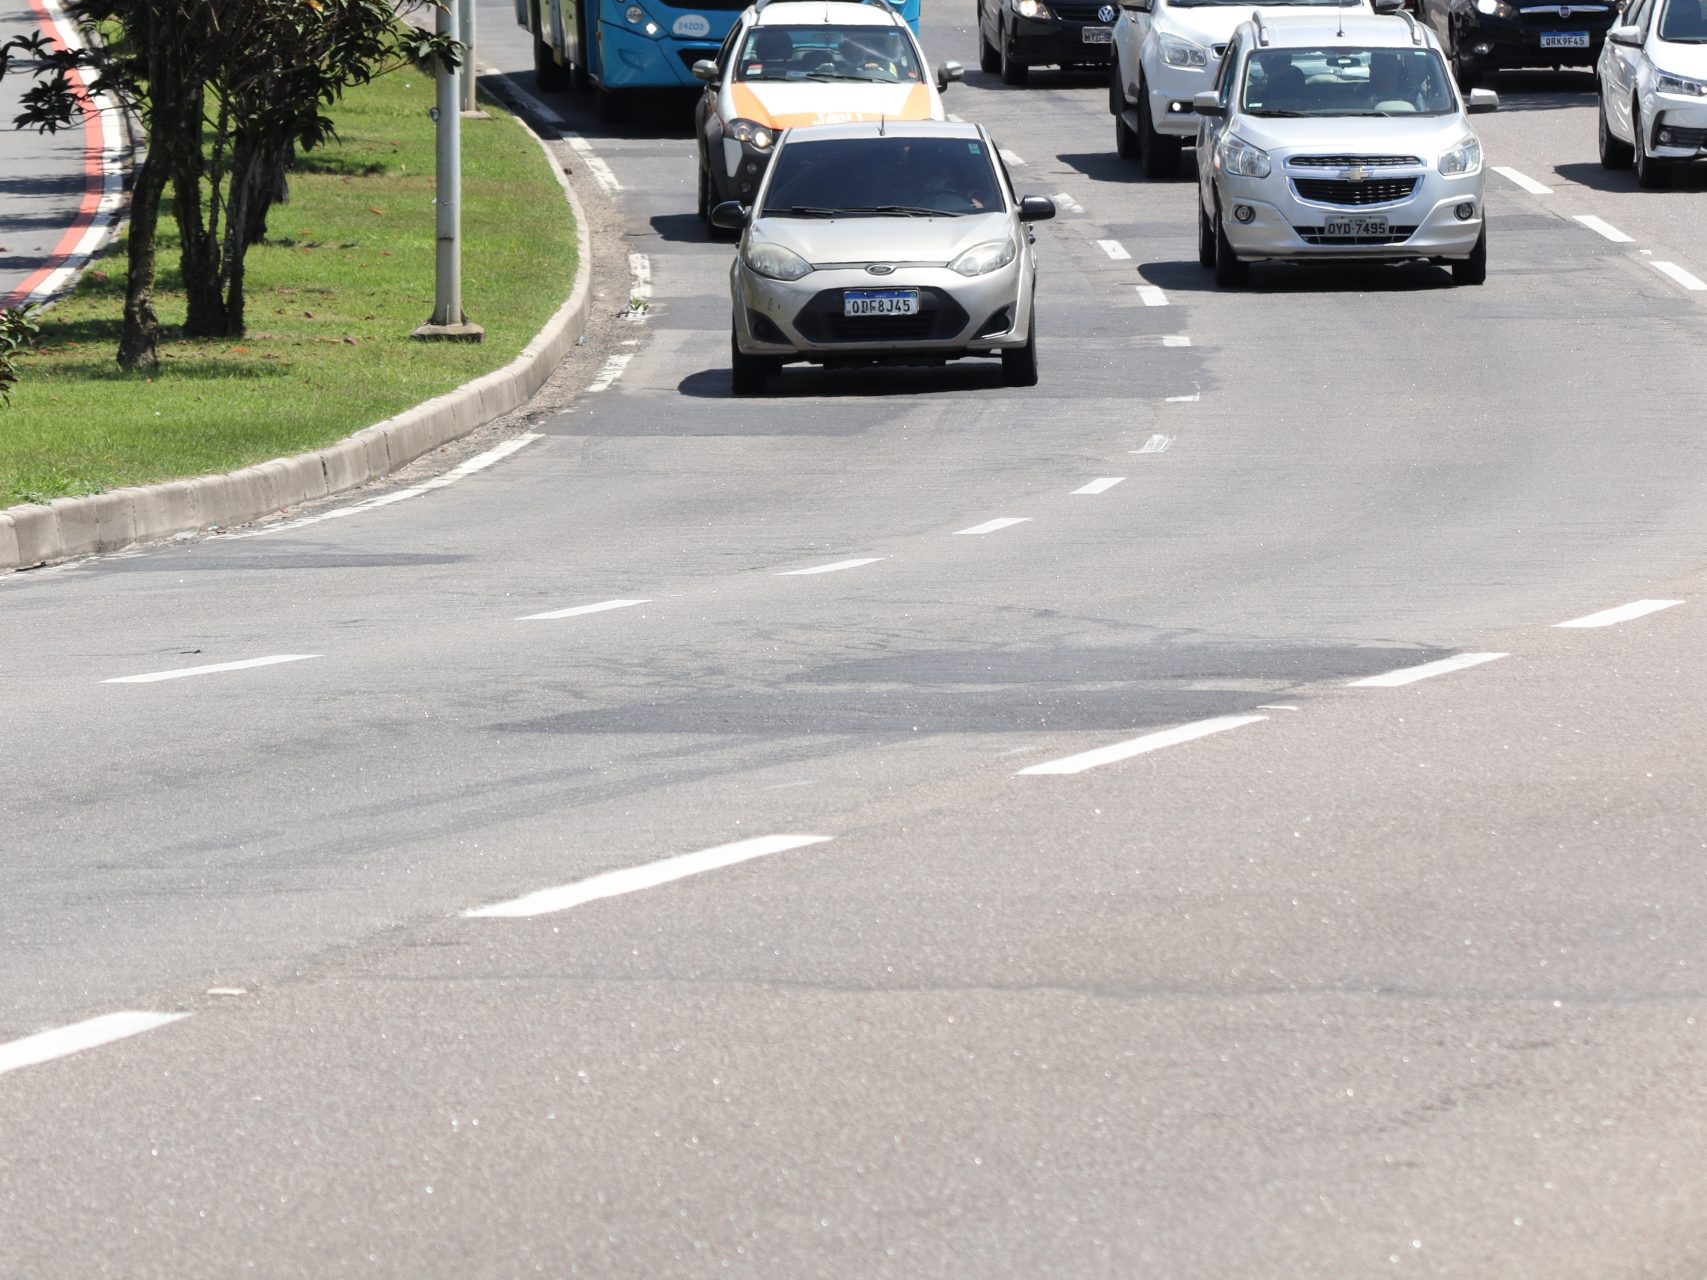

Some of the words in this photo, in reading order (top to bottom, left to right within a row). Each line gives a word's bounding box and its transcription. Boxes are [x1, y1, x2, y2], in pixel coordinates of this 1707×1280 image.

[678, 21, 704, 30] 24209
[1545, 36, 1585, 46] QRK9F45
[852, 299, 911, 314] ODF8J45
